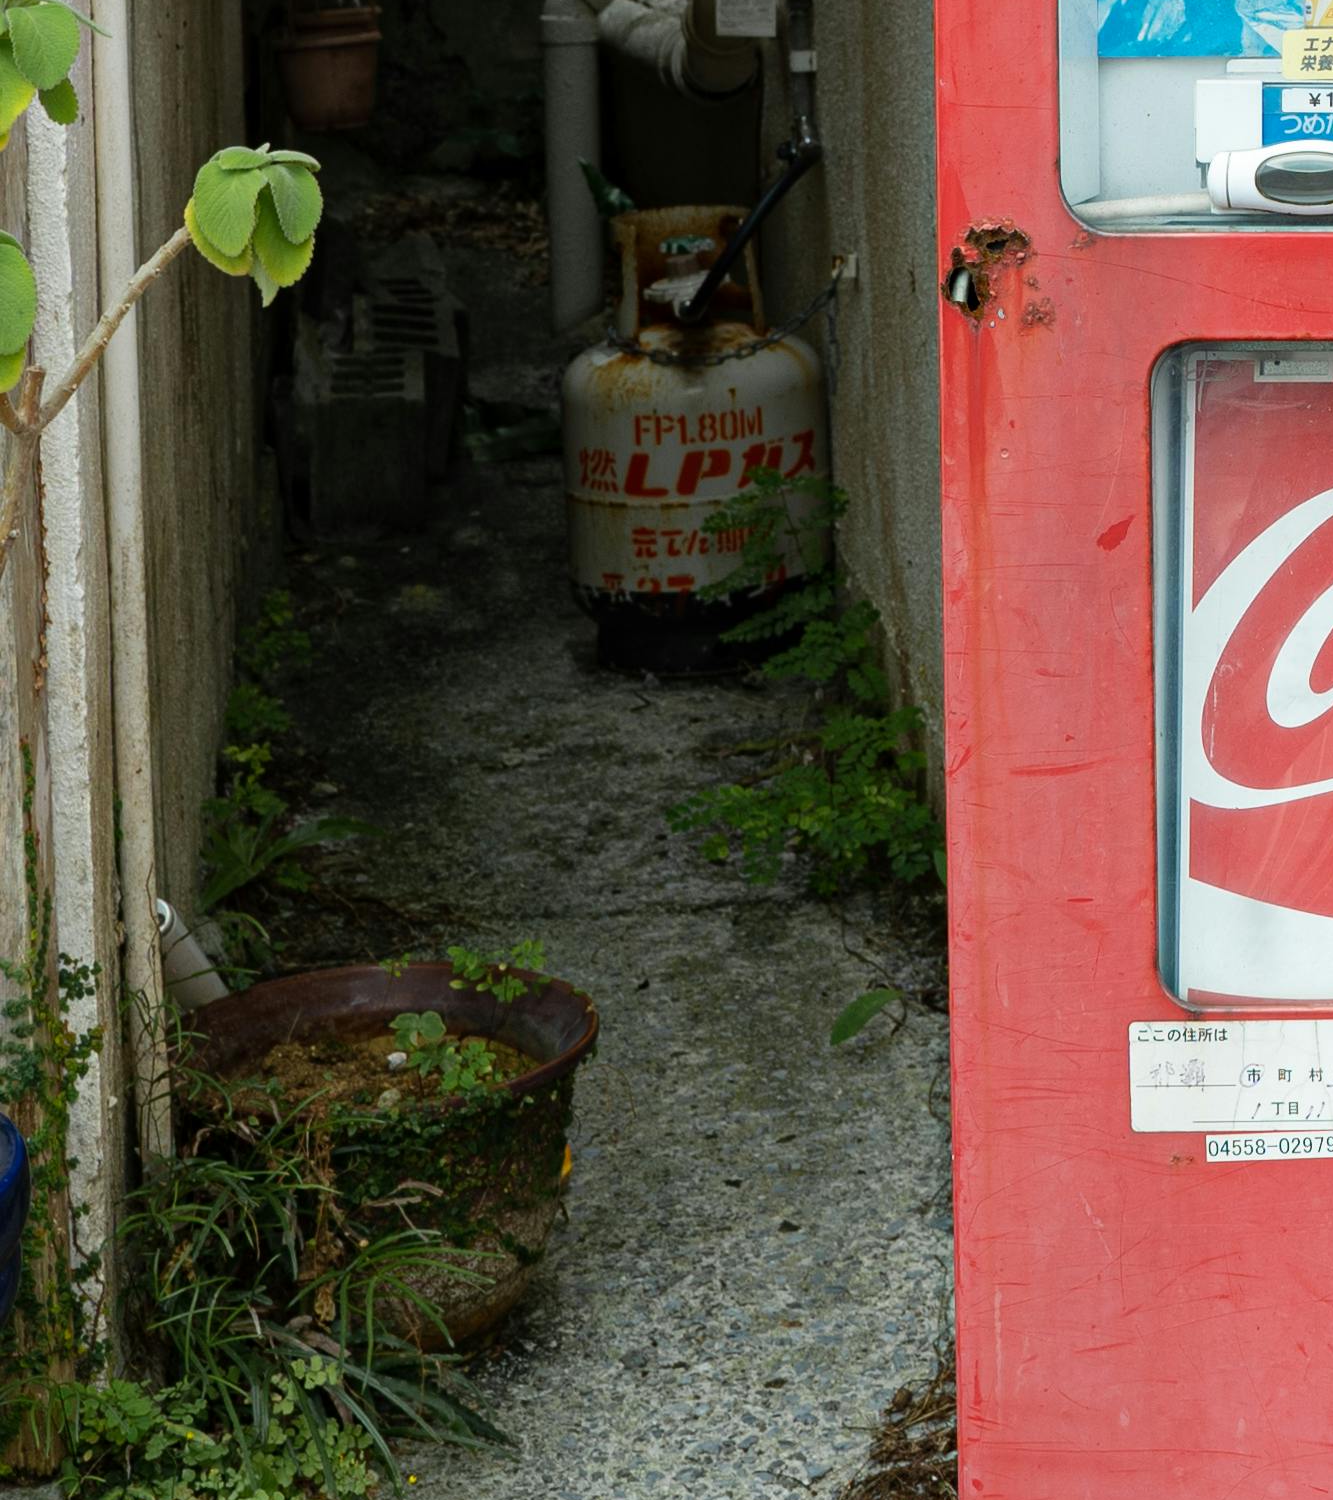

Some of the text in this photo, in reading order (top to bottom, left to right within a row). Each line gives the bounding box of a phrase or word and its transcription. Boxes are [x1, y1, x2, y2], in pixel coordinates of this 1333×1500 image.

[580, 447, 619, 493] 燃
[1137, 1028, 1228, 1042] ここの住所は
[1247, 1069, 1261, 1083] 市
[1278, 1069, 1292, 1082] 町
[1309, 1068, 1323, 1083] 村
